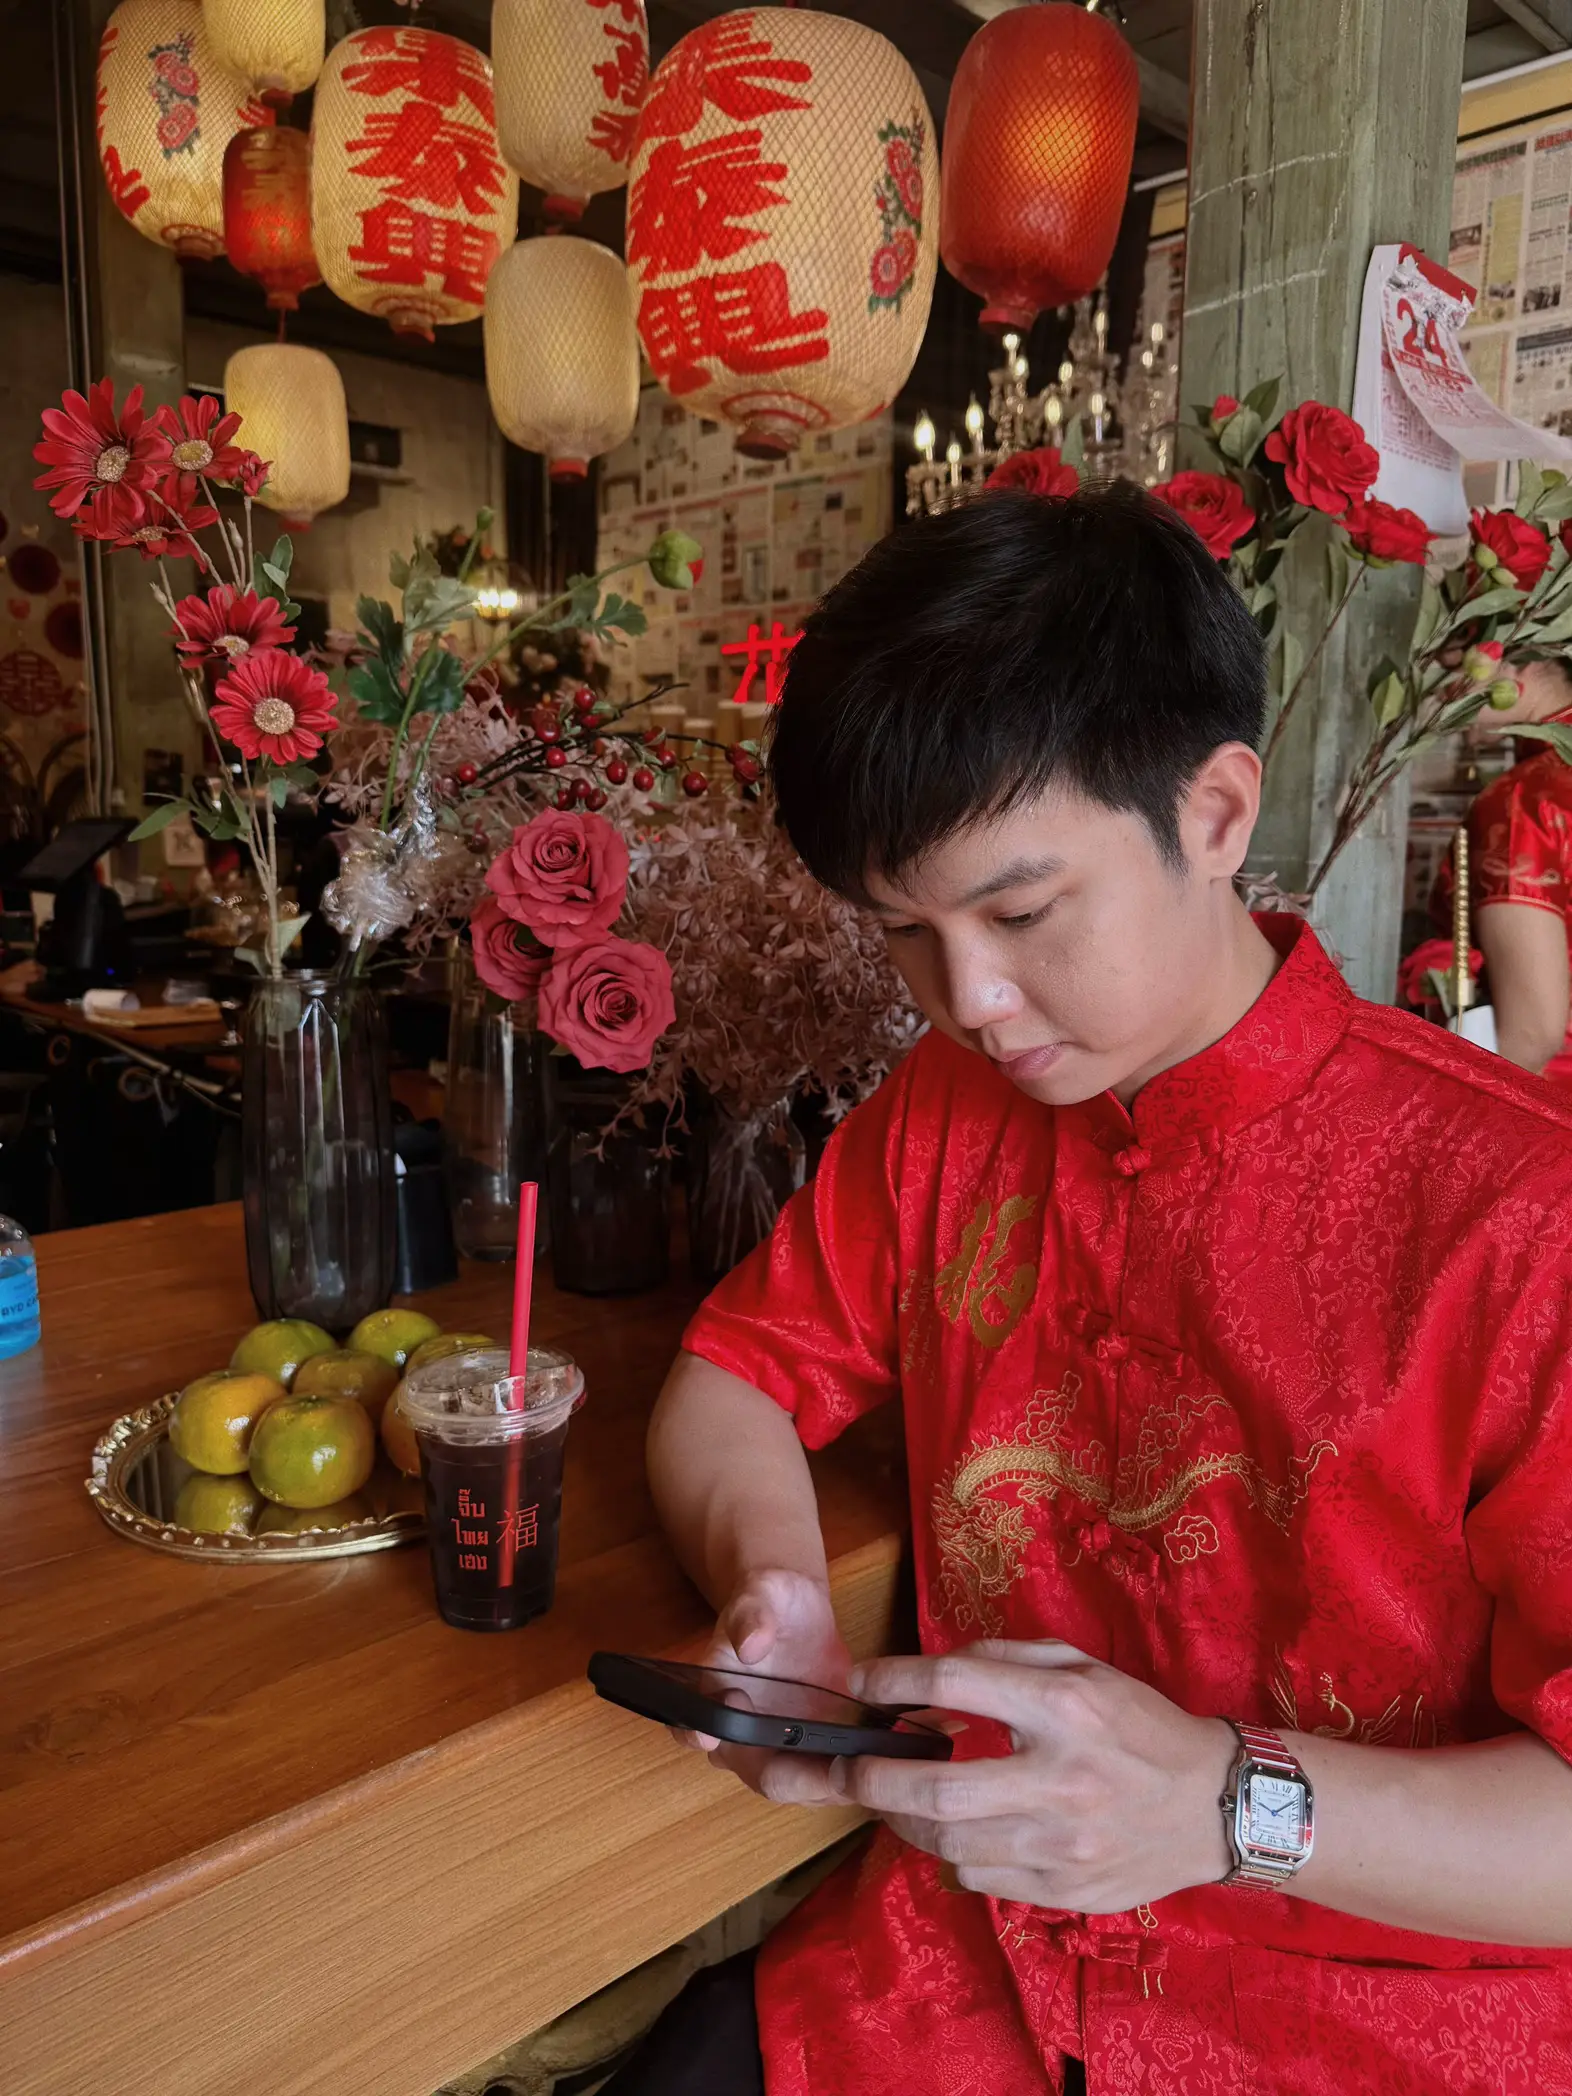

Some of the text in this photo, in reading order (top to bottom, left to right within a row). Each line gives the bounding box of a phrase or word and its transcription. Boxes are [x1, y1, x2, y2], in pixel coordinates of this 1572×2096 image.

[1397, 297, 1449, 367] 24
[450, 1517, 489, 1546] ไทย
[496, 1503, 539, 1552] 福
[459, 1553, 487, 1571] เฮง
